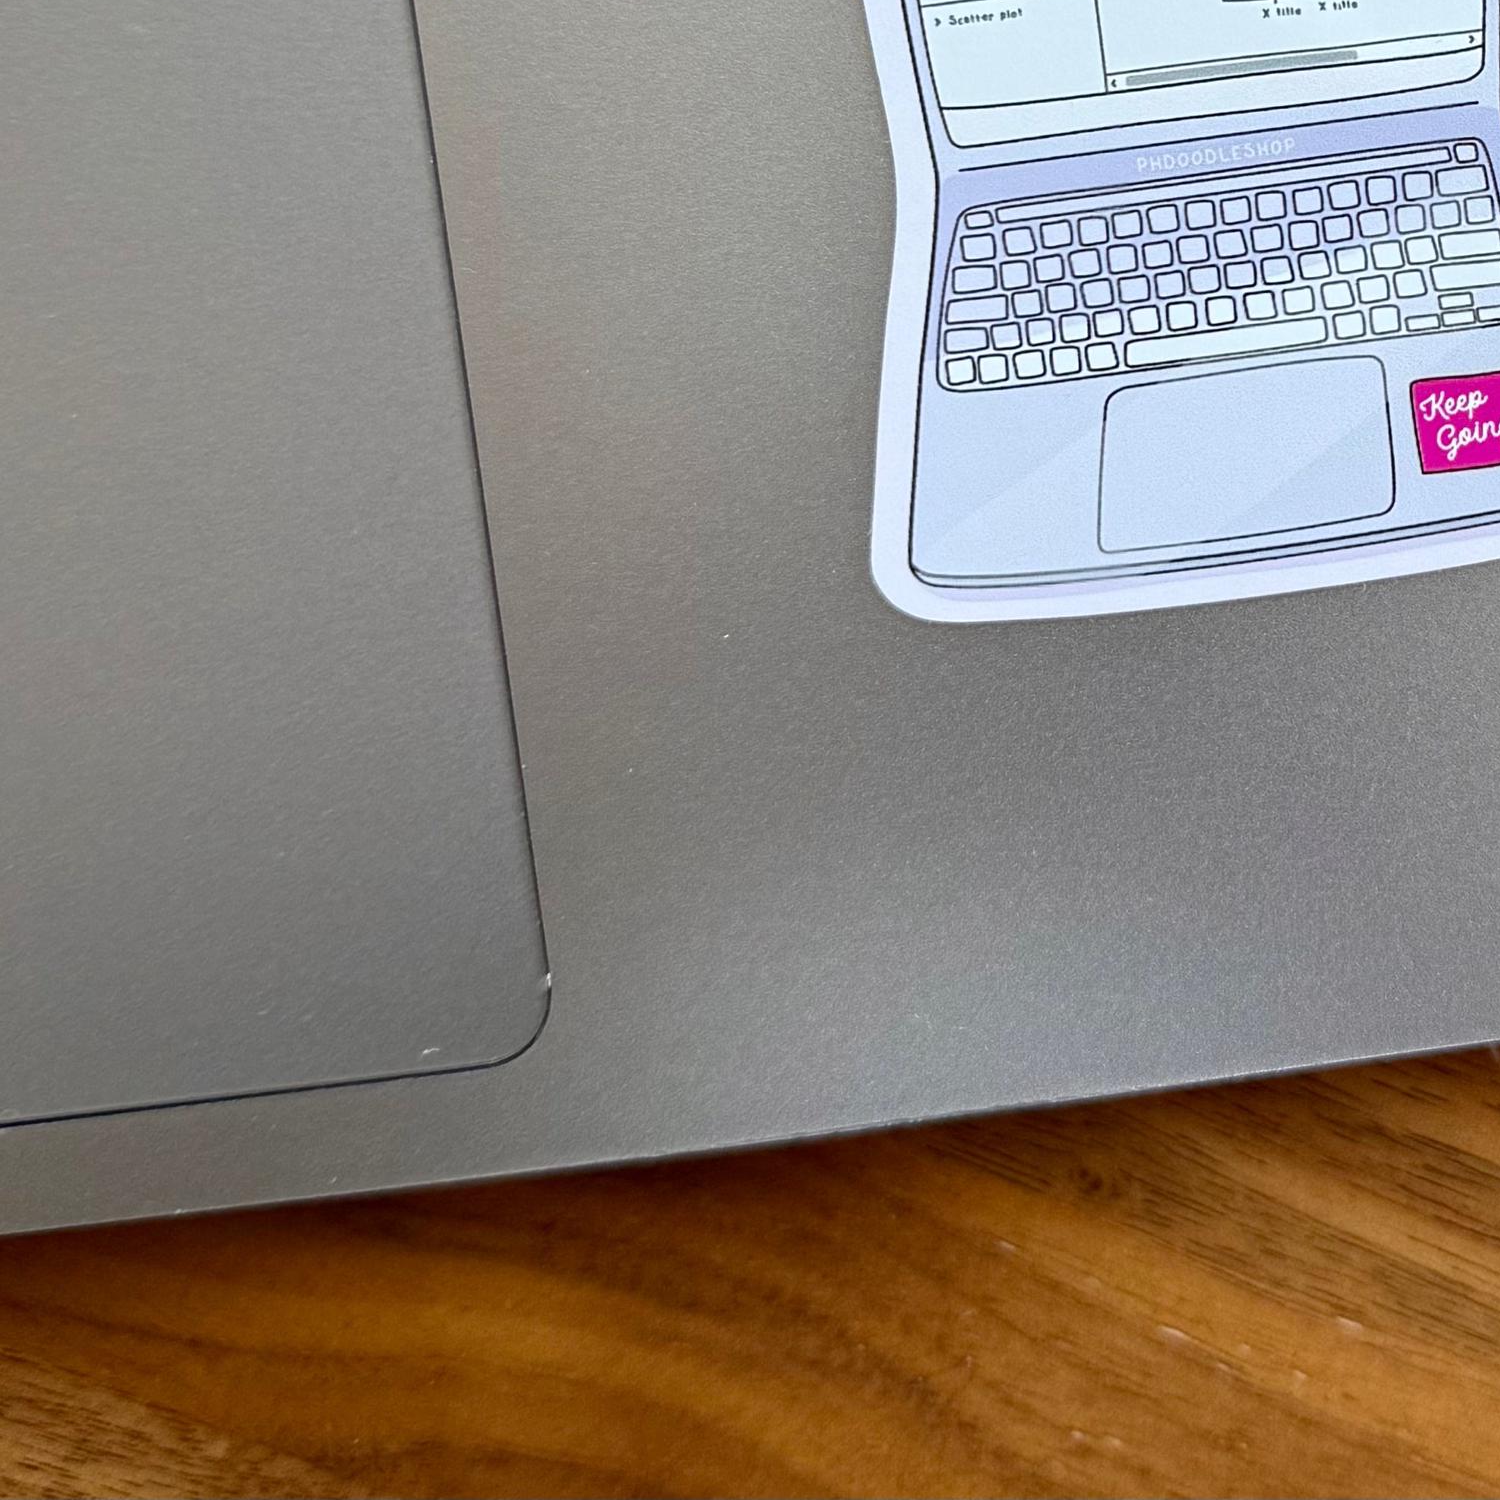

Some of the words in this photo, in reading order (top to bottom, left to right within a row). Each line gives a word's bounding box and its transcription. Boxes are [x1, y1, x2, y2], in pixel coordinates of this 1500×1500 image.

[1276, 7, 1302, 17] title
[1333, 0, 1358, 11] title
[948, 13, 995, 26] Scatter
[1000, 7, 1023, 21] plot
[1136, 137, 1296, 174] PHDOODLESHOP
[1418, 390, 1489, 421] Keep
